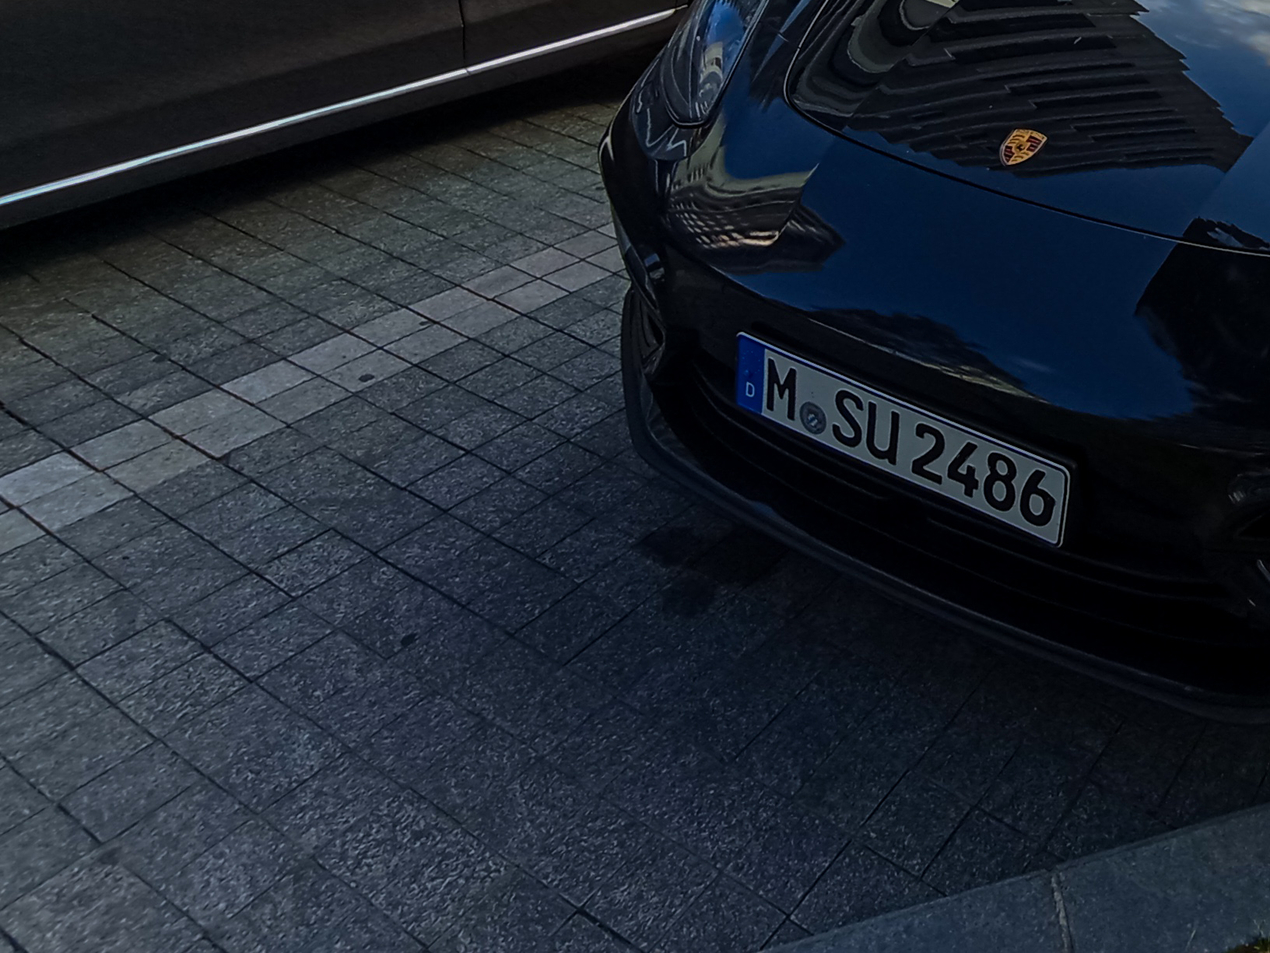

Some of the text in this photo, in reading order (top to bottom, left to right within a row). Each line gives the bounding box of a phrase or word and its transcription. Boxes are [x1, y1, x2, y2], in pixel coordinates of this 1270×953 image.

[745, 381, 755, 398] D
[766, 358, 1056, 527] M SU 2486
